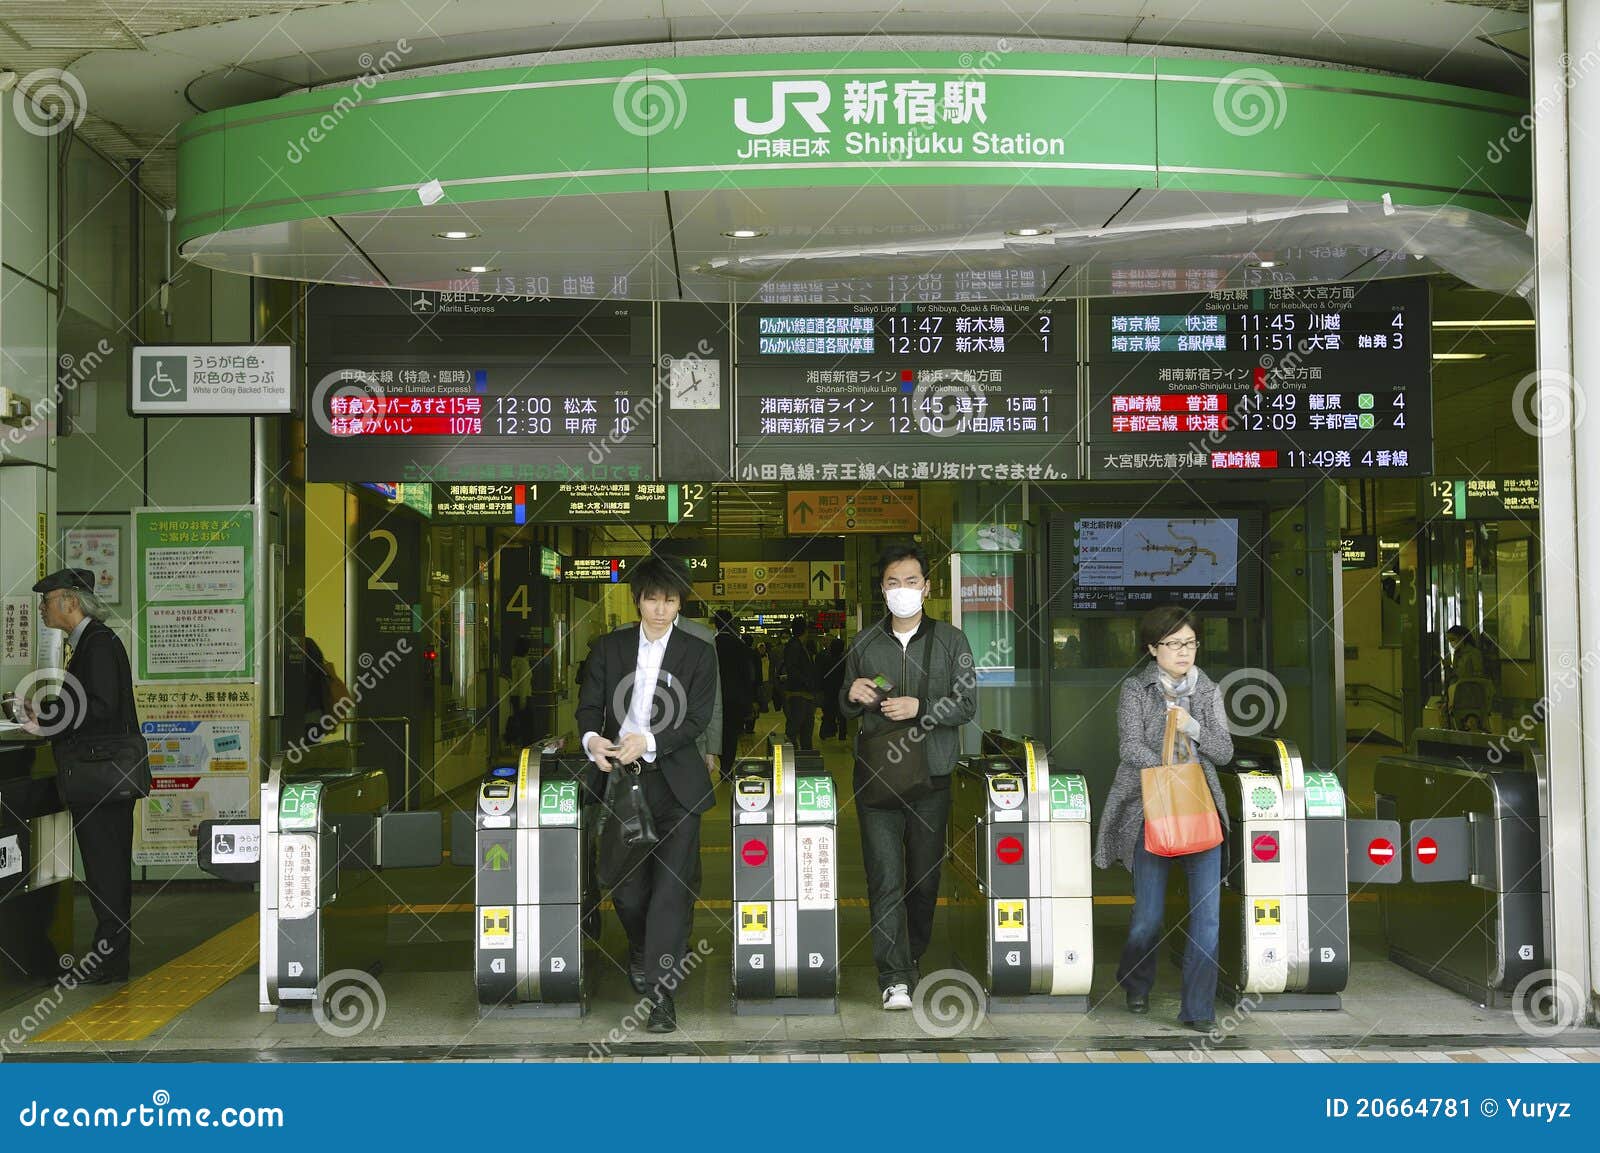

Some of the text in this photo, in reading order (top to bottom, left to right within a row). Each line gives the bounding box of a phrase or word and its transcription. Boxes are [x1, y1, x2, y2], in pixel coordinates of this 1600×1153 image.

[734, 80, 831, 135] JR
[843, 80, 987, 125] 新宿駅
[737, 138, 830, 159] JR東日本
[845, 132, 1065, 159] Shinjuku Station
[1269, 286, 1355, 299] 池袋・大宮方面
[439, 304, 495, 314] Narita Express
[881, 304, 897, 313] Line
[916, 304, 927, 313] for
[928, 304, 959, 315] Shibuya,
[1012, 303, 1030, 313] Line
[1232, 302, 1249, 311] Line
[1269, 301, 1279, 310] for
[1281, 301, 1318, 310] Ikebukuro
[760, 317, 1051, 334] りんかい線直通各駅停車 11:47 新木場 2
[1112, 313, 1403, 332] 埼京線 快速 11:45 川越 4
[760, 336, 1049, 354] りんかい線直通各駅停車 12:07 新木場 1
[1112, 333, 1403, 352] 埼京線 各駅停車 11:51 大宮 始発 3
[192, 356, 265, 369] うらが白色・
[193, 371, 274, 384] 灰色のきっぷ
[340, 370, 473, 384] 中央本線（特急・臨時）
[807, 370, 1003, 384] 湘南新宿ライン 横浜・大船方面
[1158, 366, 1323, 382] 湘南新宿ライン 大宮方面
[192, 386, 211, 394] White
[221, 387, 237, 396] Gray
[262, 386, 285, 394] Tickets
[386, 385, 472, 395] Line (Limited Express)
[881, 385, 897, 393] Line
[917, 384, 927, 393] for
[1234, 382, 1250, 390] Line
[331, 397, 630, 414] 特急スーパーあずさ15号 12:00 松本 10
[760, 397, 1049, 414] 湘南新宿ライン 11:45 逗子 15両 1
[1112, 393, 1405, 412] 高崎線 普通 11:49 籠原 4
[331, 418, 630, 434] 特急かいじ 107号 12:30 甲府 10
[760, 417, 1049, 434] 湘南新宿ライン 12:00 小田原 15両 1
[1112, 413, 1405, 432] 宇都宮線 快速 12:09 宇都宮 4
[1103, 451, 1409, 469] 大宮駅先着列車 高崎線 11:49発 4番線
[742, 463, 1068, 481] 小田急線・京王線へは通り抜けできません。
[450, 485, 538, 500] 湘南新宿ライン 1
[683, 502, 694, 518] 2
[1442, 499, 1454, 515] 2
[367, 529, 399, 590] 2
[618, 559, 626, 569] 4
[505, 584, 532, 620] 4
[799, 779, 815, 806] 入口
[1051, 777, 1068, 804] 入口
[1305, 774, 1321, 801] 入口
[282, 787, 299, 813] 入口
[542, 783, 559, 809] 入口
[801, 837, 815, 901] 通り抜け出来ません
[1010, 953, 1017, 963] 3
[1067, 953, 1074, 962] 4
[1266, 951, 1273, 960] 4
[1323, 950, 1330, 960] 5
[1523, 947, 1530, 957] 5
[496, 961, 502, 970] 1
[553, 960, 561, 969] 2
[754, 957, 761, 966] 2
[812, 956, 819, 965] 3
[292, 964, 298, 974] 1
